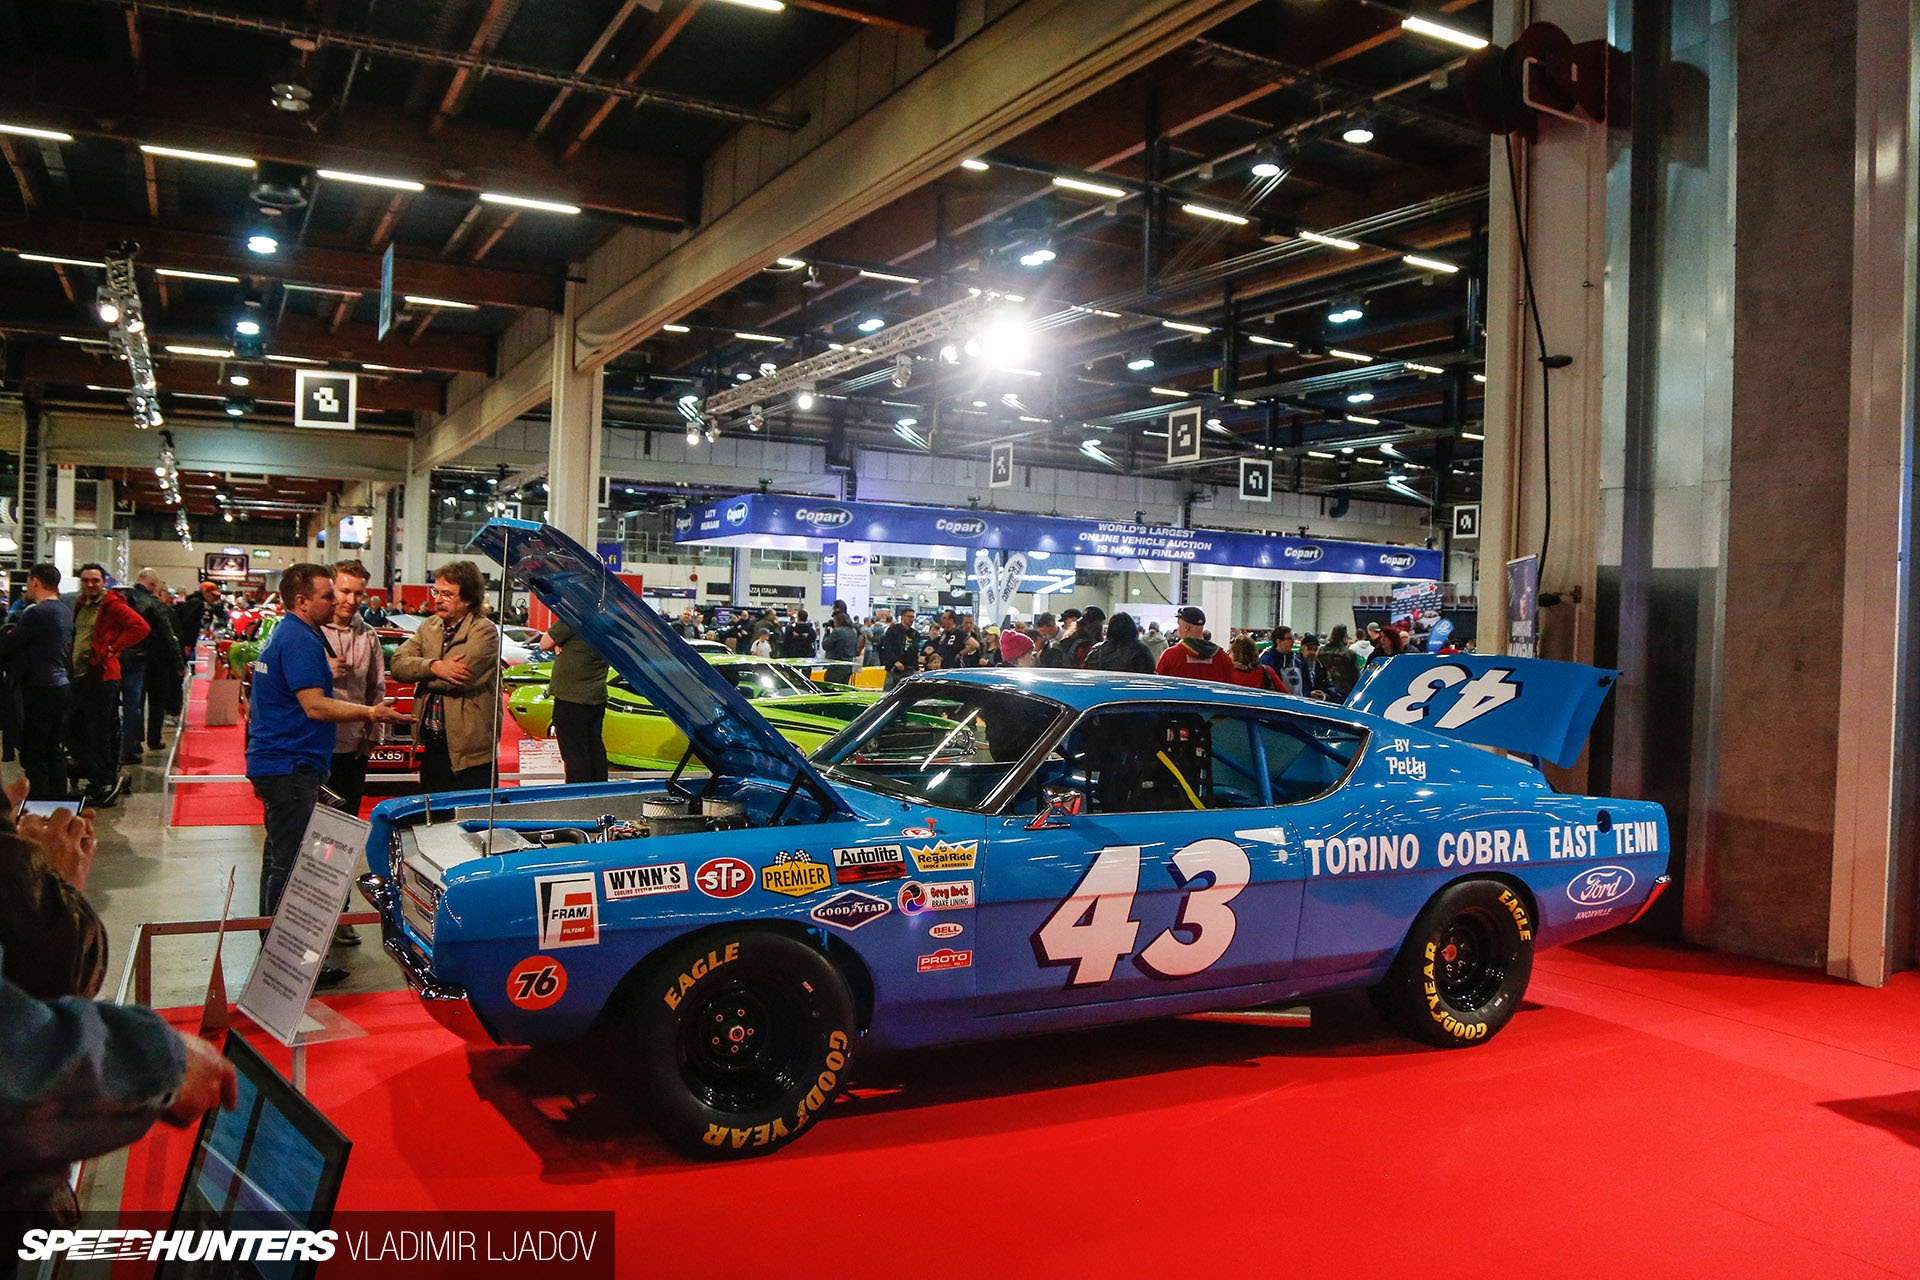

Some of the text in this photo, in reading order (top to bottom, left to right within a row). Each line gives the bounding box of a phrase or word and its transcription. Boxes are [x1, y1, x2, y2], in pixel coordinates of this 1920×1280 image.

[796, 508, 847, 524] Copart
[936, 519, 983, 534] Copart
[1098, 523, 1196, 538] WORLD'S LARGEST
[1079, 532, 1212, 551] ONLINE VEHICLE AUCTION
[1097, 545, 1196, 560] IS NOW IN FINLAND
[1284, 547, 1320, 560] Copart
[1379, 554, 1412, 566] Copart
[1383, 663, 1523, 730] 43
[1394, 738, 1410, 752] BY
[1386, 756, 1427, 778] Petty
[840, 846, 898, 865] Autolite
[1304, 821, 1658, 875] TORINO COBRA EAST TENN
[608, 866, 681, 890] WYNN'S
[704, 862, 747, 891] STP
[765, 867, 827, 888] PREMIER
[1581, 868, 1623, 901] Ford
[932, 898, 968, 907] BRAKE LINING
[1031, 837, 1252, 990] 43
[1498, 889, 1532, 942] EAGLE
[1575, 907, 1613, 920] KNOXVILLE
[933, 926, 960, 934] BELL
[921, 953, 968, 965] PROTO
[514, 965, 559, 1001] 76
[664, 942, 740, 1010] EAGLE
[1424, 941, 1488, 1039] GOODYEAR
[703, 1030, 848, 1149] GOODYEAR
